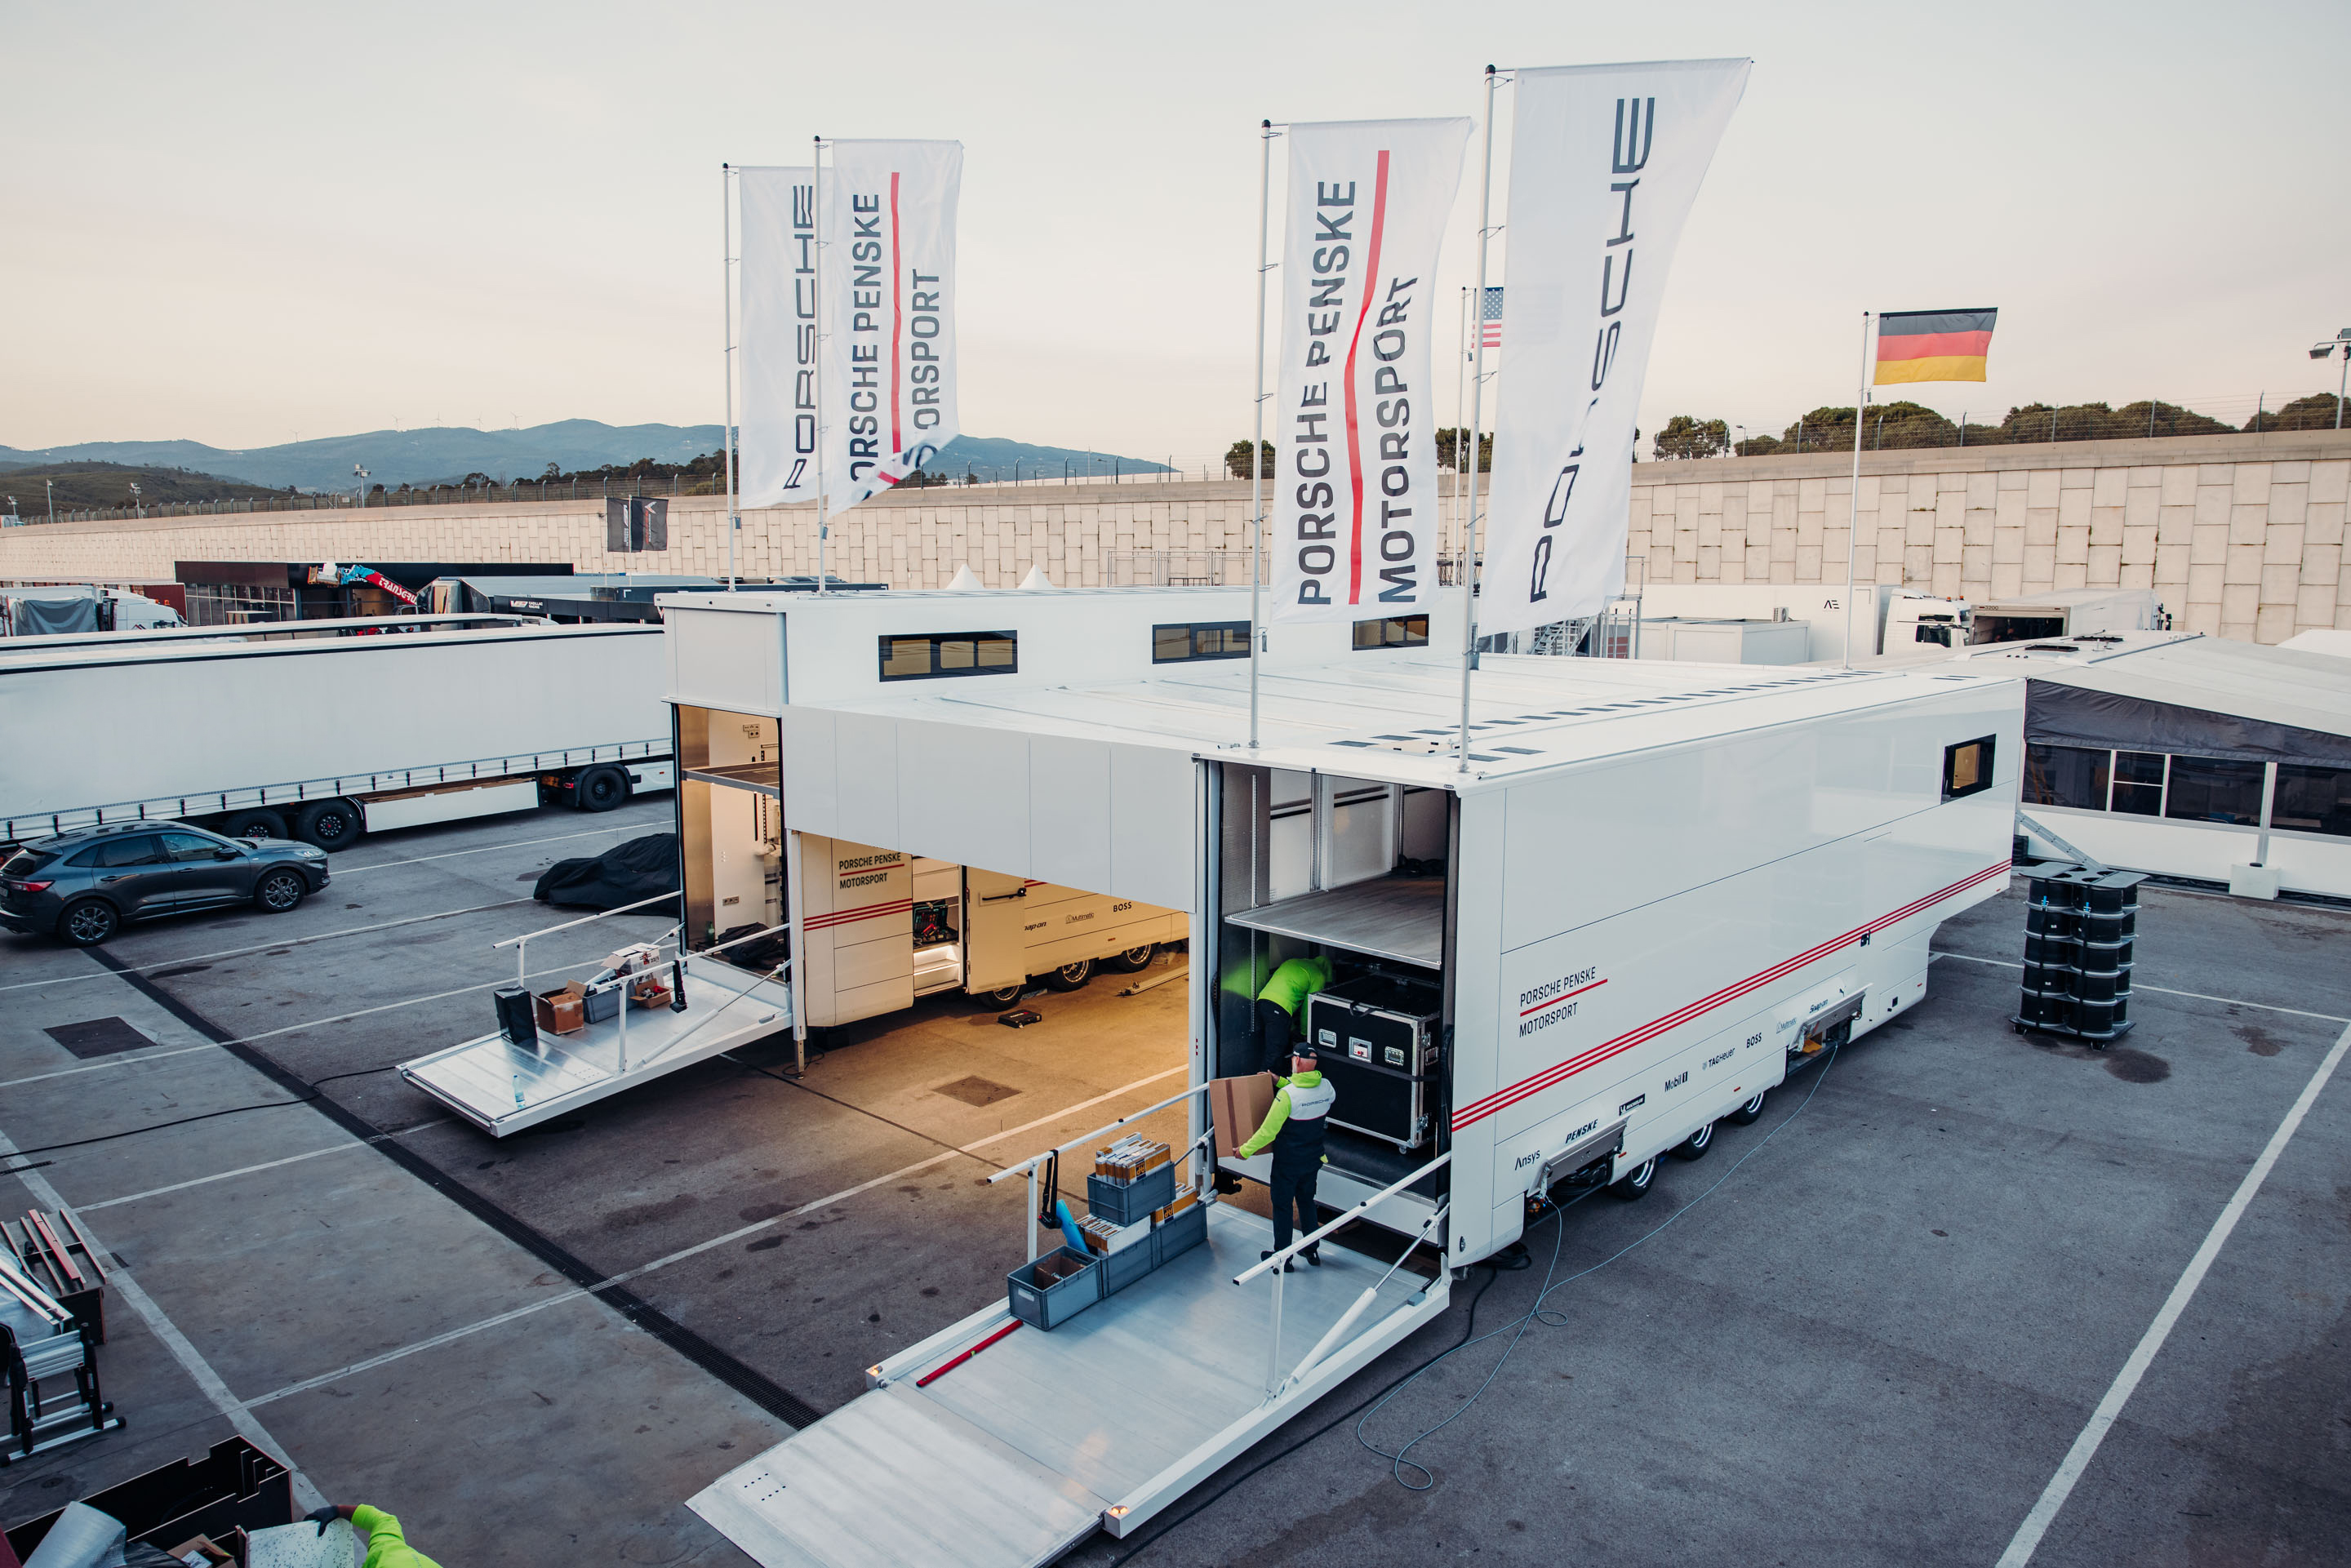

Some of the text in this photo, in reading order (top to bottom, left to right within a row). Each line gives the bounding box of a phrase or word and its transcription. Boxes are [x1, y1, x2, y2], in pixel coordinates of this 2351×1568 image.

[784, 184, 816, 490] PORSCHE
[849, 193, 882, 482] ORSCHE PENSKE
[1297, 180, 1356, 605] PORSCHE PENSKE
[1373, 276, 1419, 603] MOTORSPORT
[839, 852, 901, 870] PORSCHE PENSKE
[839, 873, 887, 890] MOTORSPORT
[1113, 901, 1132, 913] BOSS
[1520, 966, 1596, 1007] PORSCHE PENSKE
[1519, 1002, 1578, 1038] MOTORSPORT
[1746, 1032, 1762, 1049] BOSS
[1301, 1098, 1330, 1107] PORSCHE
[1565, 1118, 1598, 1144] PENSKE
[1514, 1149, 1540, 1170] Ansys
